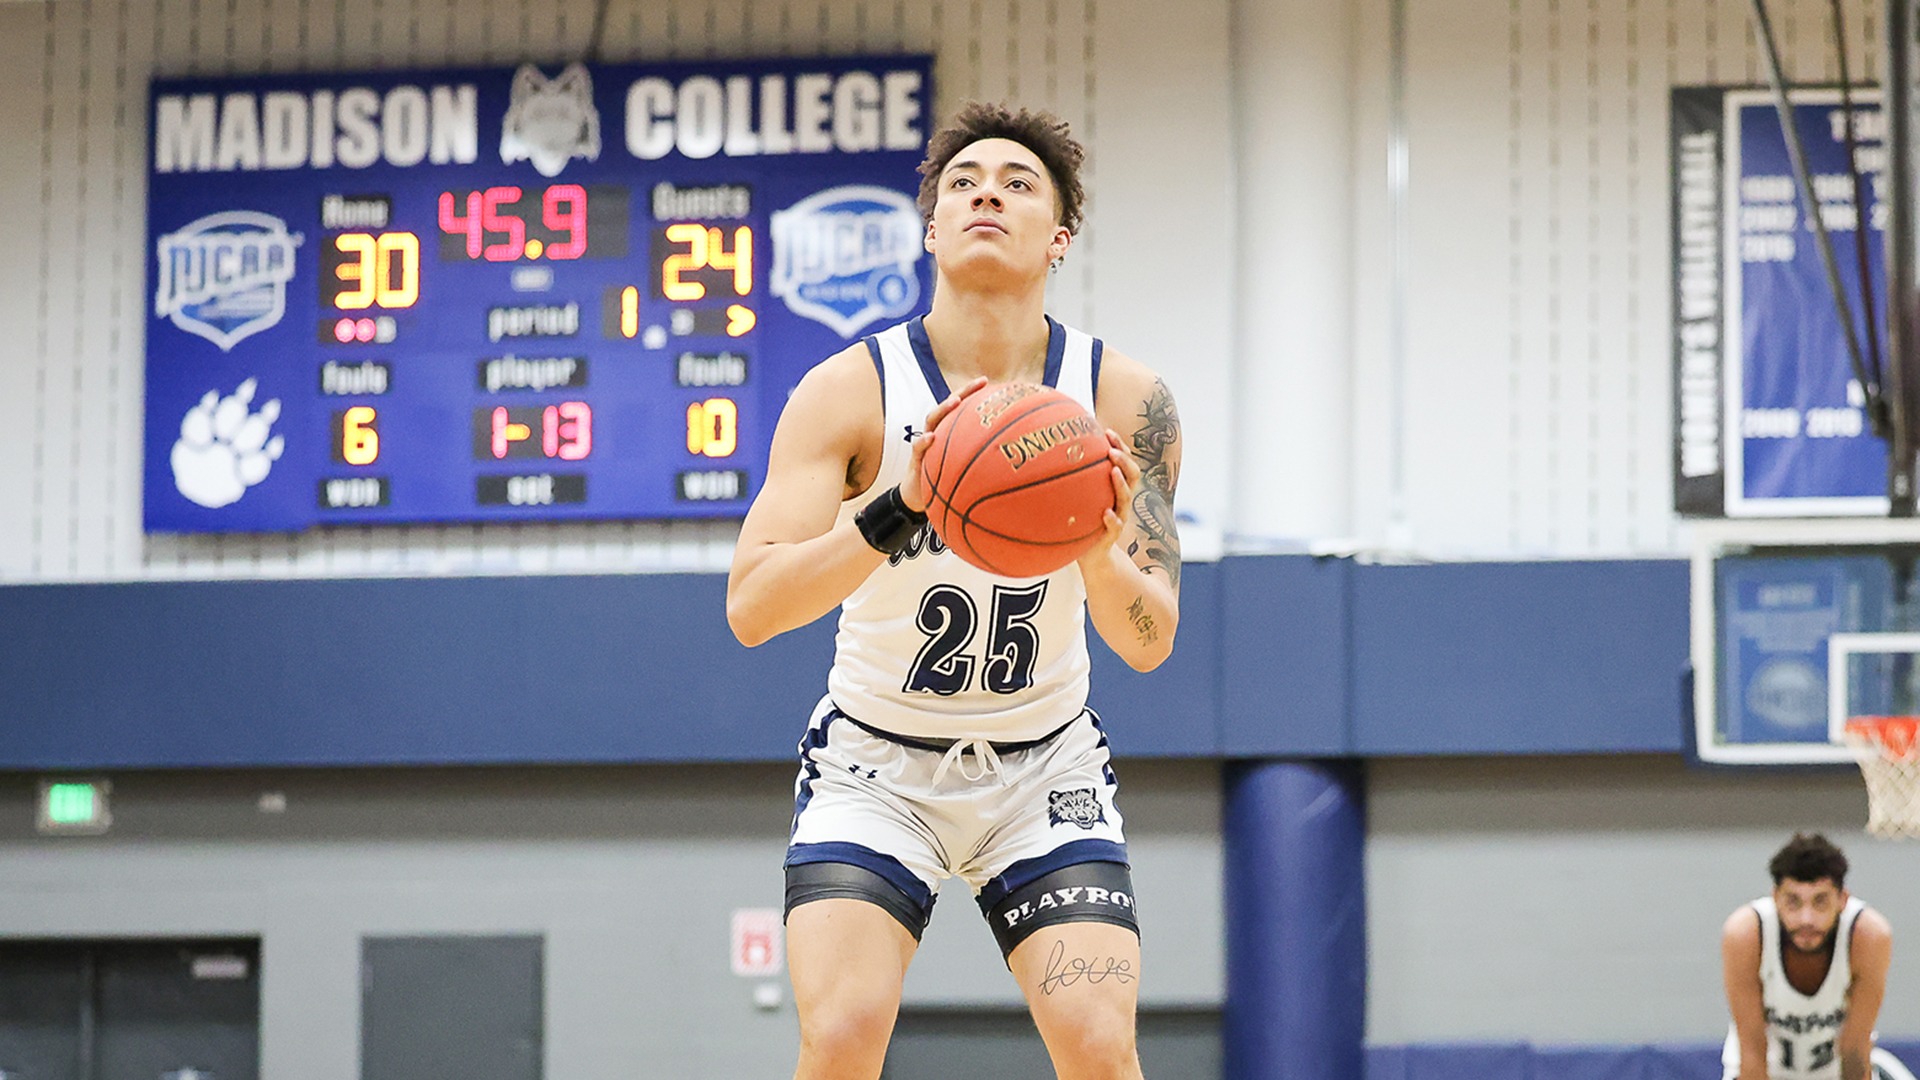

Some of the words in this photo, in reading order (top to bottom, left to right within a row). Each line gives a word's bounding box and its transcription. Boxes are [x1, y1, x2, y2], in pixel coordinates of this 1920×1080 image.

[156, 85, 478, 172] MADISON
[625, 71, 923, 159] COLLEGE
[438, 184, 588, 262] 45.9
[334, 231, 420, 309] 30
[662, 223, 753, 301] 24
[621, 285, 640, 339] 1
[342, 406, 380, 465] 6
[686, 397, 738, 457] 10
[1000, 414, 1103, 472] PALDING
[902, 579, 1049, 695] 25
[1038, 940, 1136, 996] love
